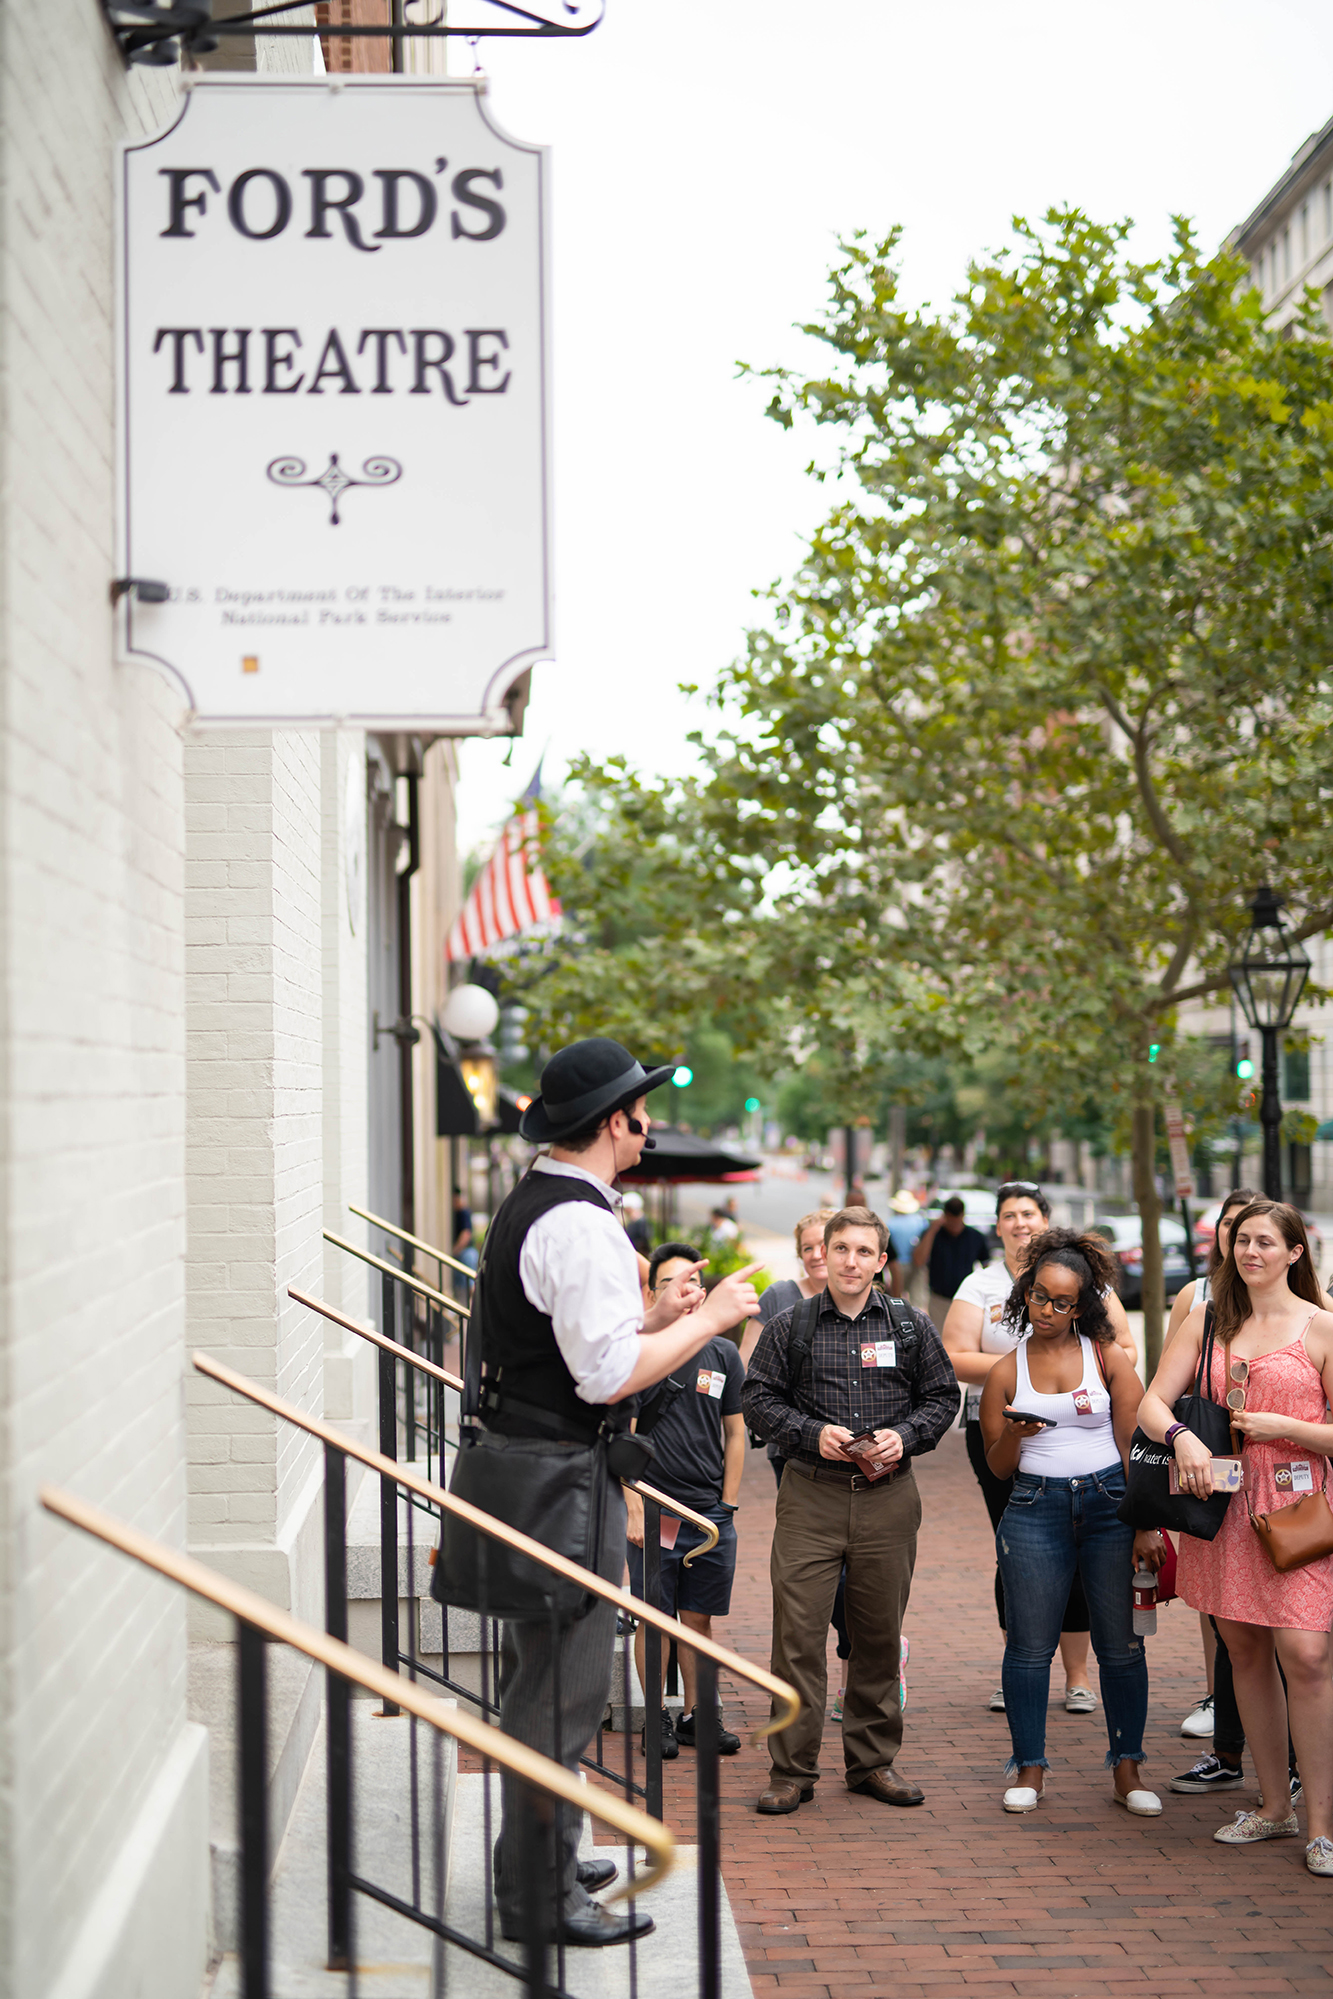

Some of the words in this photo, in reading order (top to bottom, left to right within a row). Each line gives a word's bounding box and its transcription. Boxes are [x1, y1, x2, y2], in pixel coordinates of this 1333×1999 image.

[158, 156, 507, 252] FORD'S
[152, 327, 512, 406] THEATRE
[215, 586, 338, 606] Department
[345, 585, 370, 602] Of
[377, 585, 416, 602] The
[424, 585, 506, 602] Interior
[221, 609, 310, 625] National
[318, 608, 367, 625] Park
[375, 607, 453, 625] Service
